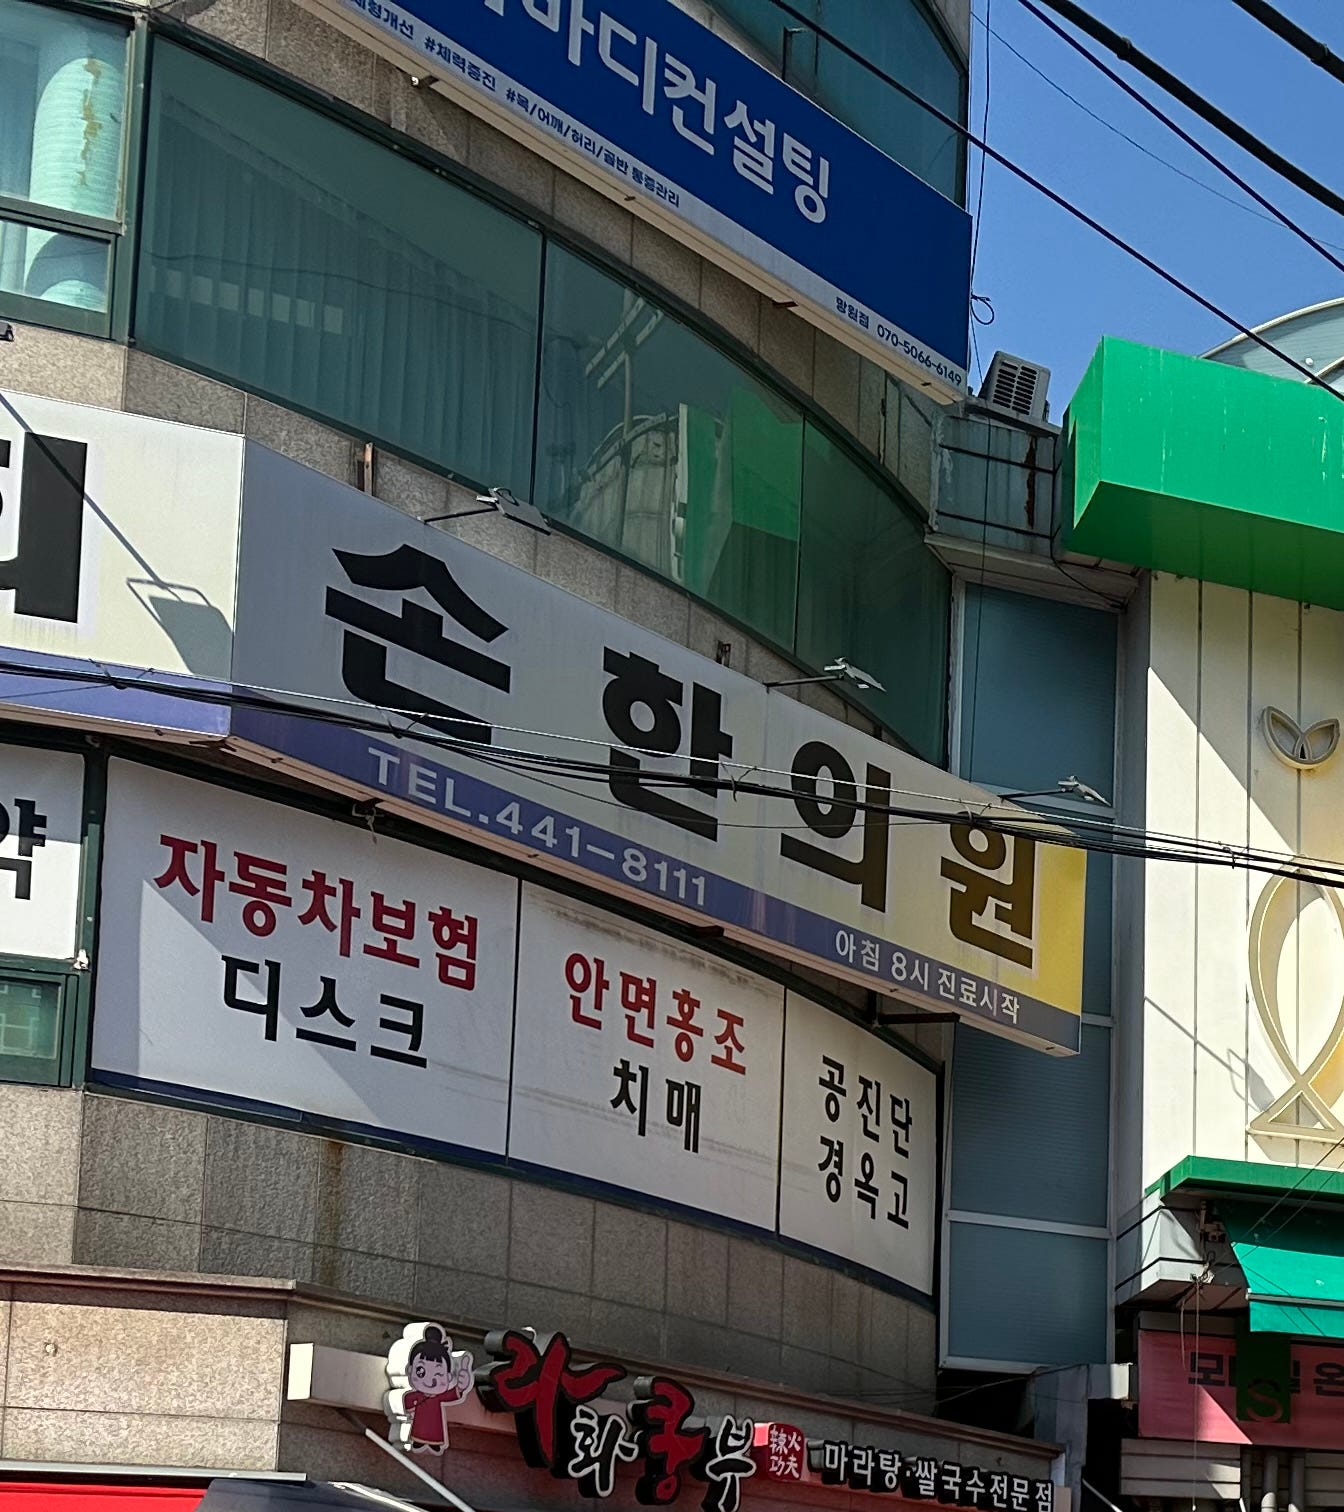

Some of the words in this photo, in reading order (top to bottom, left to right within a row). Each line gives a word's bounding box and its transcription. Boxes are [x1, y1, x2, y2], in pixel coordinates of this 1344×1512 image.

[483, 0, 830, 224] 디컨설팅
[836, 297, 870, 330] 망원점
[877, 324, 962, 386] 070-5066-6149
[368, 747, 706, 906] TEL.441-8111
[154, 834, 480, 992] 자동차보험
[220, 954, 428, 1068] 디스크
[564, 952, 748, 1076] 안면홍조
[835, 930, 880, 973] 아침
[891, 951, 929, 991] 8시
[938, 968, 1020, 1024] 진료시작
[611, 1058, 702, 1154] 치매
[818, 1054, 914, 1163] 공진단
[817, 1134, 910, 1230] 경옥고
